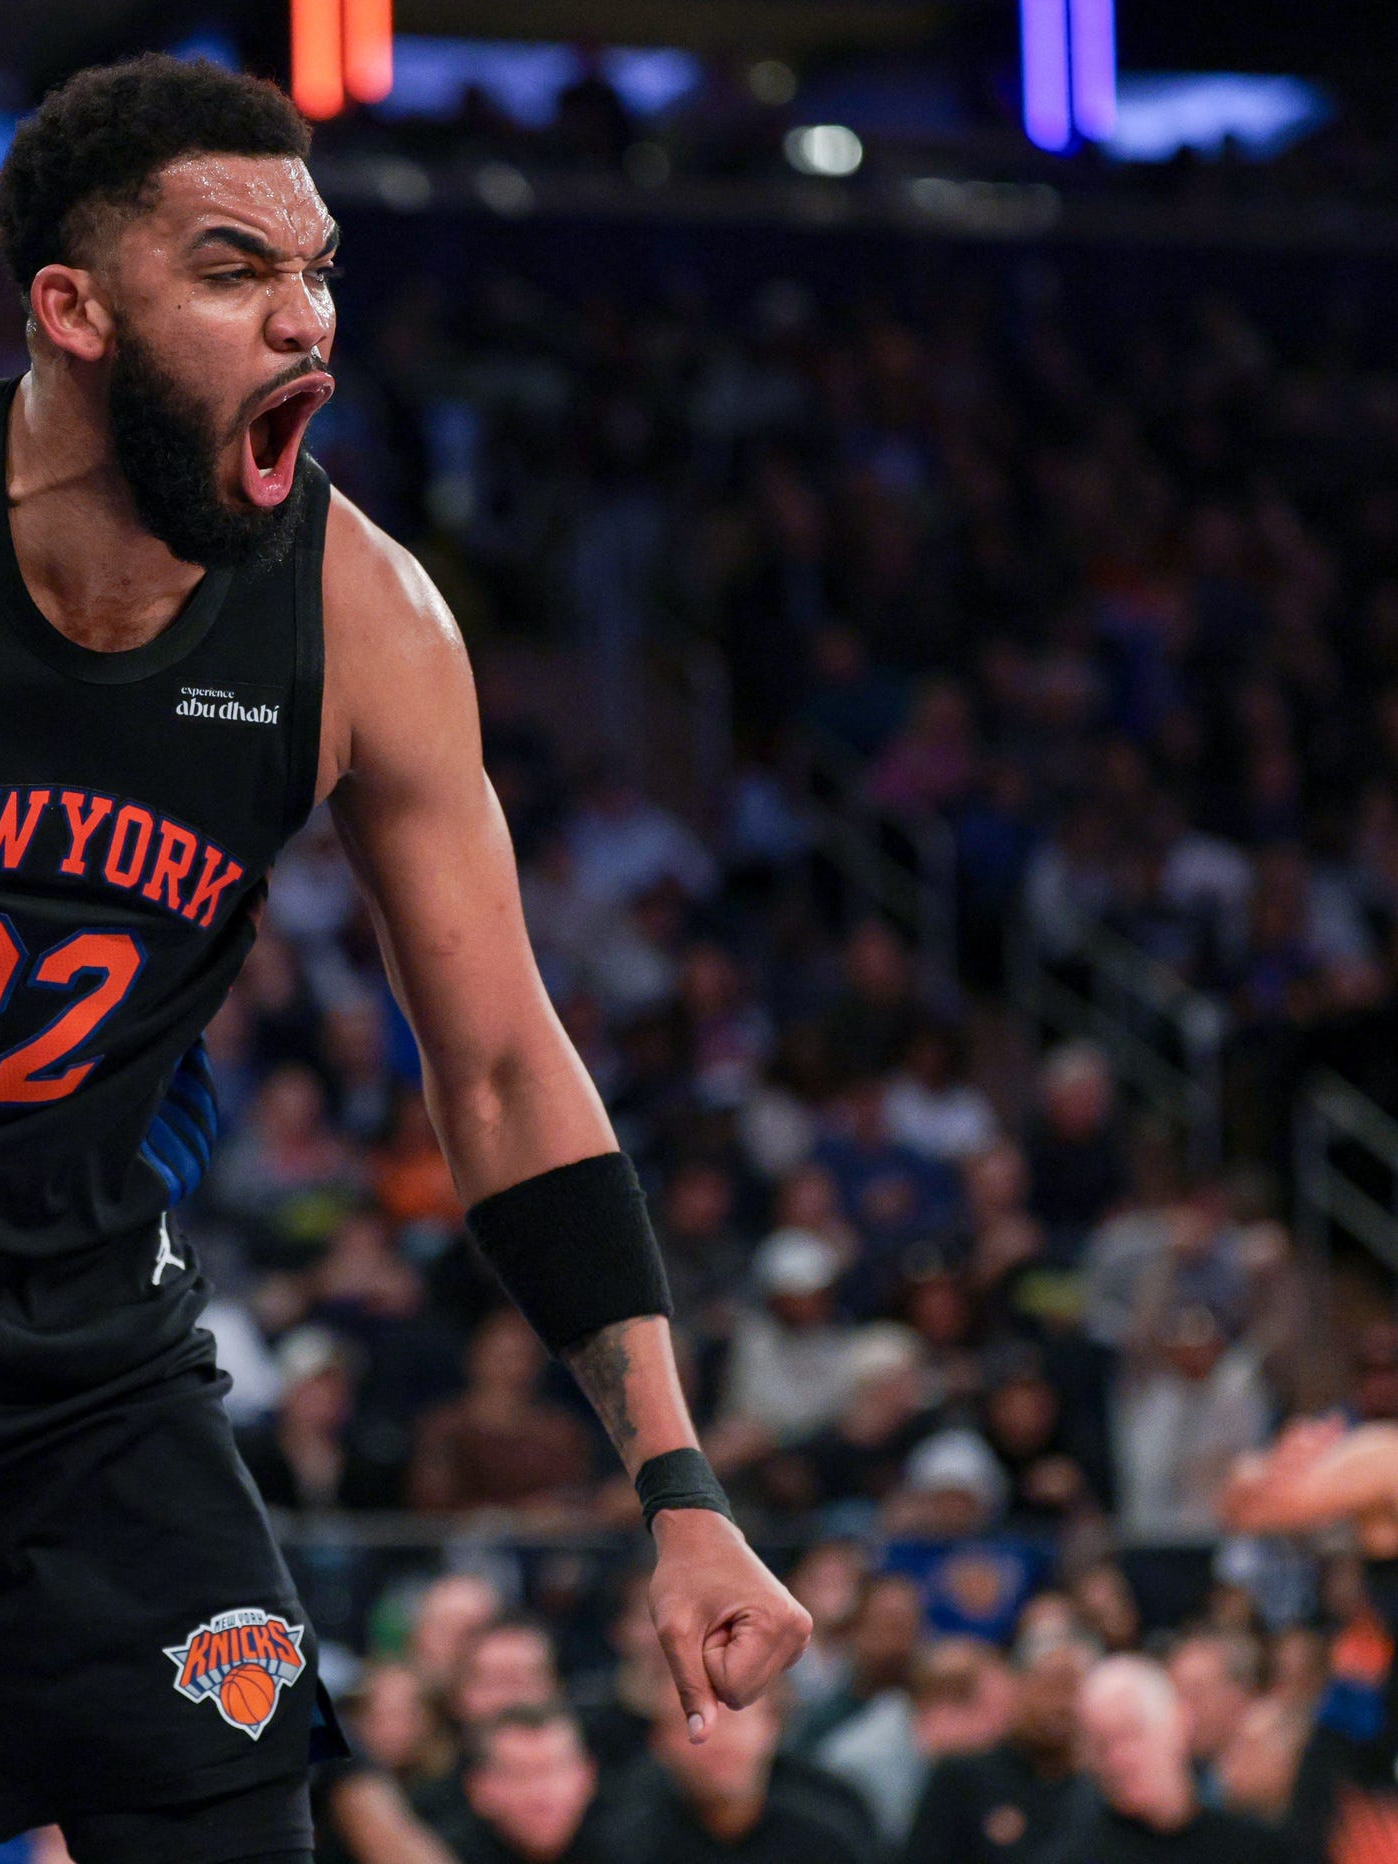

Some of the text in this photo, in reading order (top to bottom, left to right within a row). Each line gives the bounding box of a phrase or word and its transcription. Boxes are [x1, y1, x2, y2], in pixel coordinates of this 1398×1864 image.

[180, 686, 235, 698] experience
[175, 698, 280, 724] abu dhabi
[58, 790, 244, 930] YORK
[214, 1615, 236, 1631] NEW
[179, 1619, 302, 1688] KNICKS
